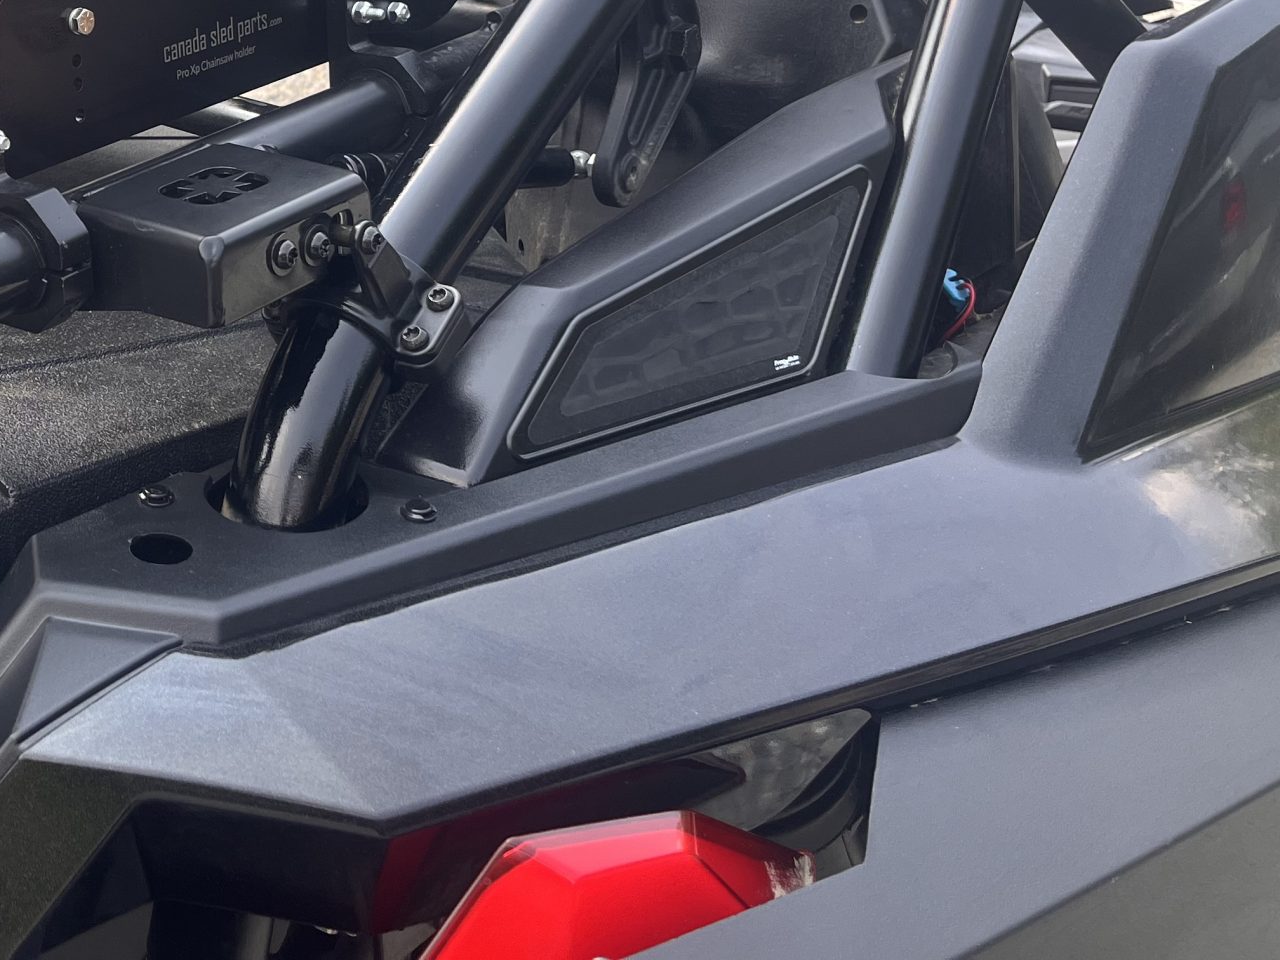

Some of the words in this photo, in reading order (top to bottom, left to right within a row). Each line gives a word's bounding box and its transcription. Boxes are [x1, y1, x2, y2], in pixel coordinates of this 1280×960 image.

[163, 27, 207, 63] canada
[210, 16, 234, 47] sled
[176, 69, 190, 80] Pro
[200, 52, 234, 72] Chainsaw
[234, 45, 256, 59] holder
